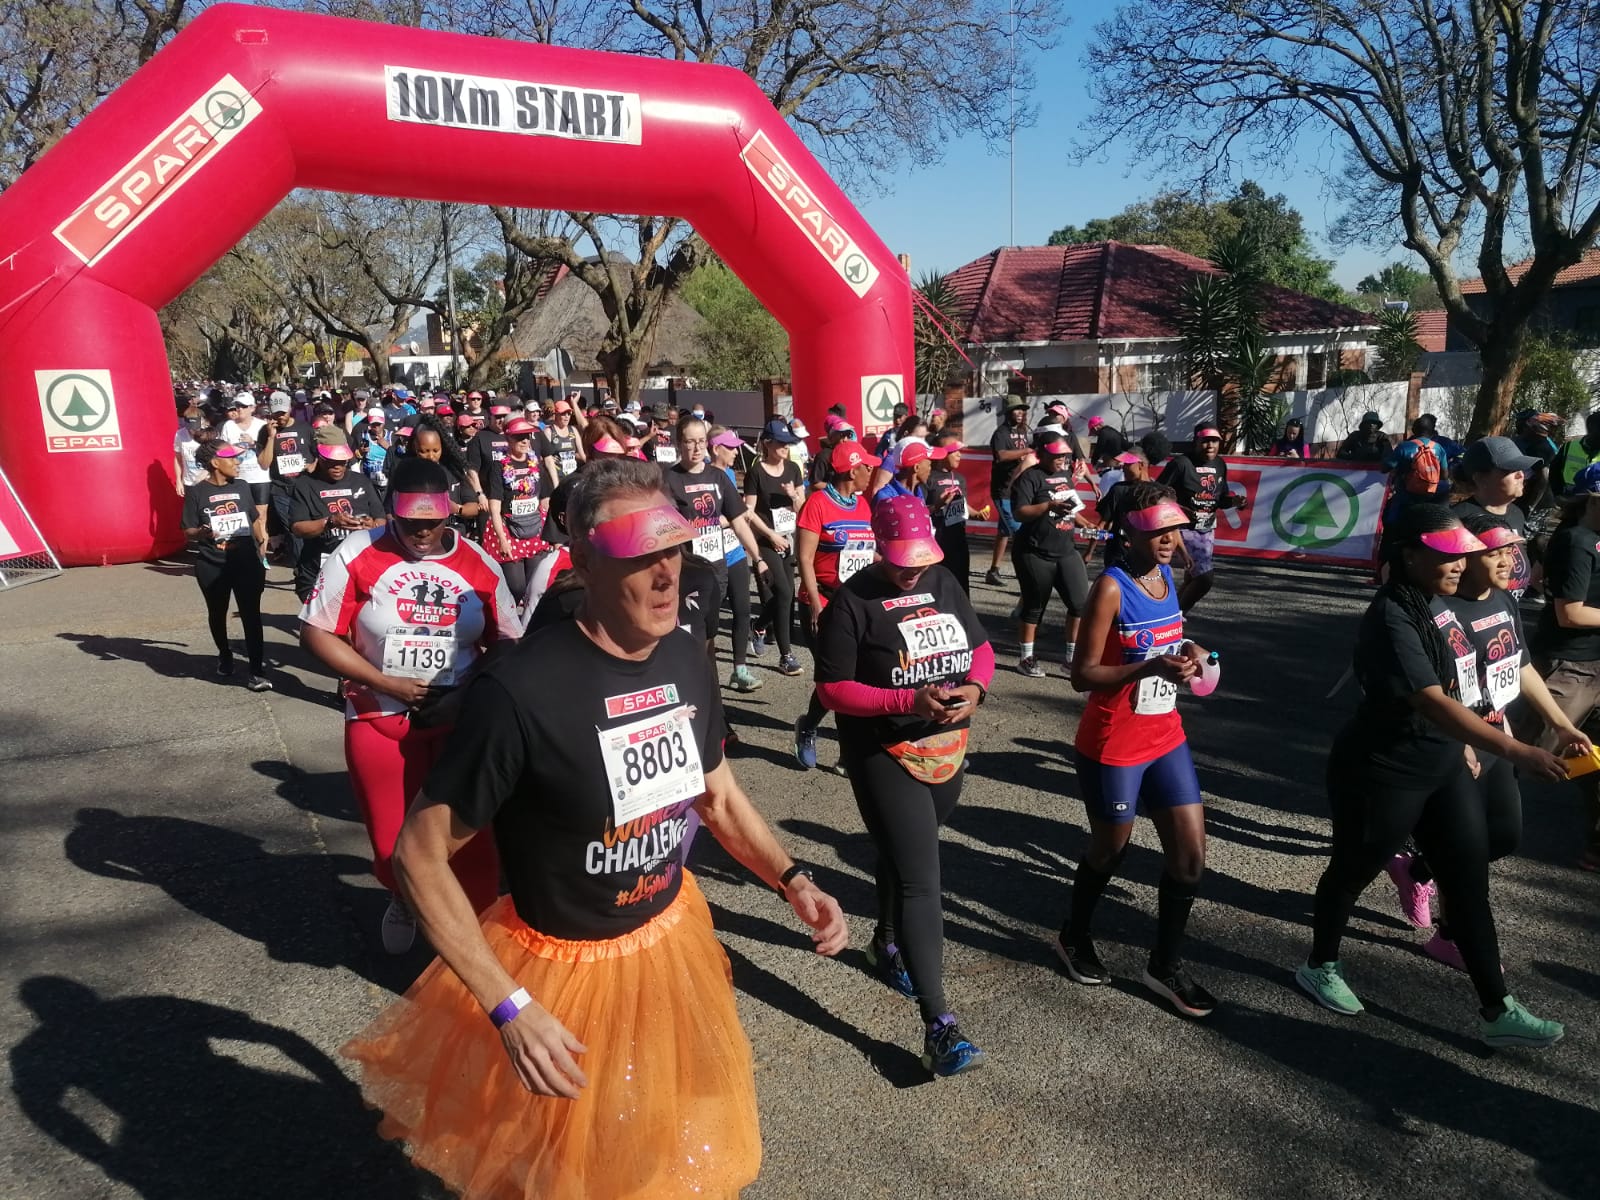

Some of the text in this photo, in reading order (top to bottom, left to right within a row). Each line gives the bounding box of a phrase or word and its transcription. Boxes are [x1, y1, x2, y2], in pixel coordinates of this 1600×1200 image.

[393, 72, 624, 137] 10Km START
[94, 124, 209, 229] SPAR
[767, 163, 845, 256] SPAR
[52, 436, 118, 448] SPAR
[516, 502, 536, 514] 6723
[218, 518, 243, 532] 2177
[699, 538, 719, 554] 1964
[388, 571, 469, 604] KATLEHONG
[399, 602, 458, 616] ATHLETICS
[892, 597, 920, 608] SPAR
[413, 613, 440, 623] CLUB
[914, 623, 959, 651] 2012
[397, 647, 446, 670] 1139
[623, 690, 666, 711] SPAR
[637, 726, 666, 742] SPAR
[623, 731, 688, 786] 8803
[585, 818, 688, 875] CHALLENG
